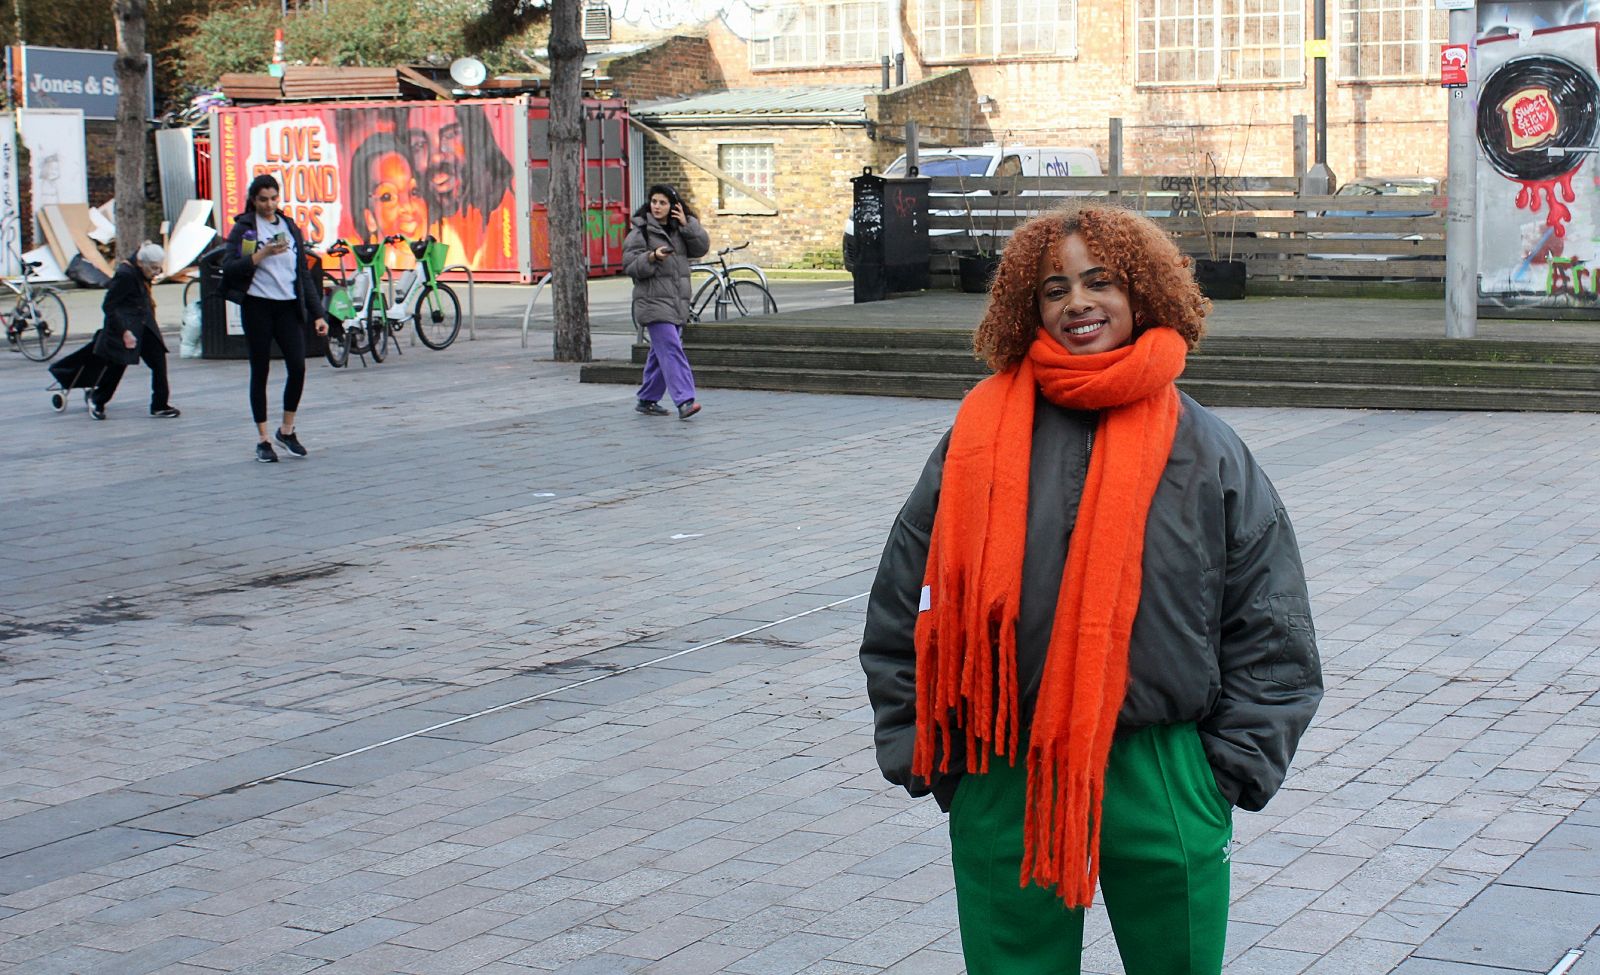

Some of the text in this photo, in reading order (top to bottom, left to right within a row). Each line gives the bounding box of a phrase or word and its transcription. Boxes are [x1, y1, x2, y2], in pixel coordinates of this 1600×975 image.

[30, 73, 83, 93] Jones
[84, 75, 101, 95] &
[265, 126, 321, 162] LOVE
[253, 164, 337, 203] YOND
